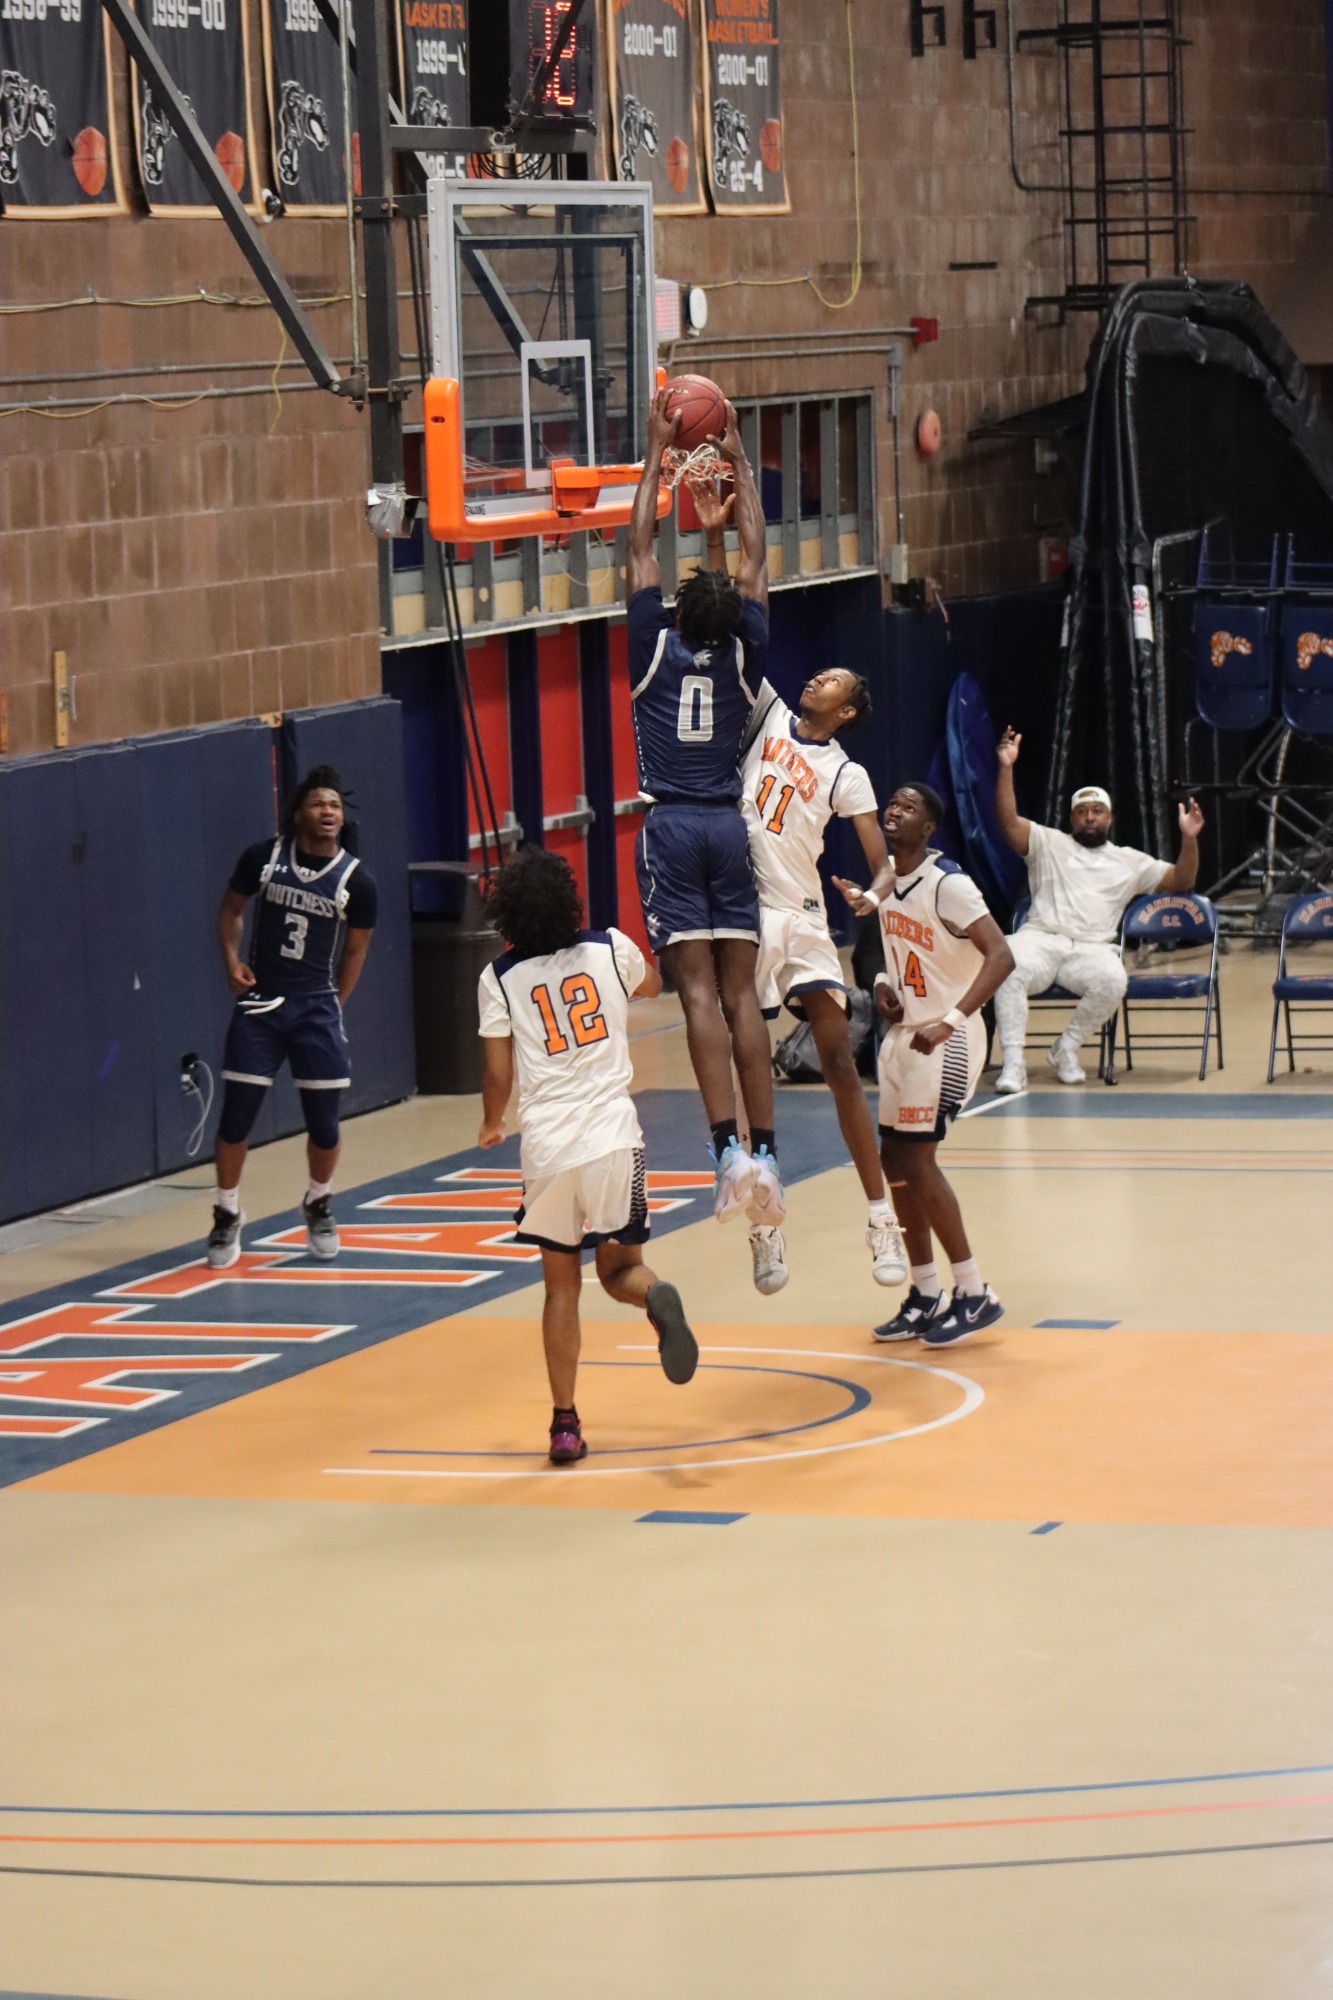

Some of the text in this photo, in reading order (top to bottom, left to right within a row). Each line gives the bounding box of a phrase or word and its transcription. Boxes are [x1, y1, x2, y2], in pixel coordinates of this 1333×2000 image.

[152, 0, 226, 31] 1999-00
[624, 22, 678, 58] 2000-01
[718, 53, 769, 87] 2000-01
[729, 160, 763, 193] 25-4
[676, 674, 714, 742] 0
[755, 773, 796, 836] 11
[266, 881, 336, 919] DUTCHESS
[1137, 896, 1205, 926] MANHATTAN
[279, 911, 310, 961] 3
[530, 971, 610, 1057] 12
[898, 1106, 935, 1124] BMCC
